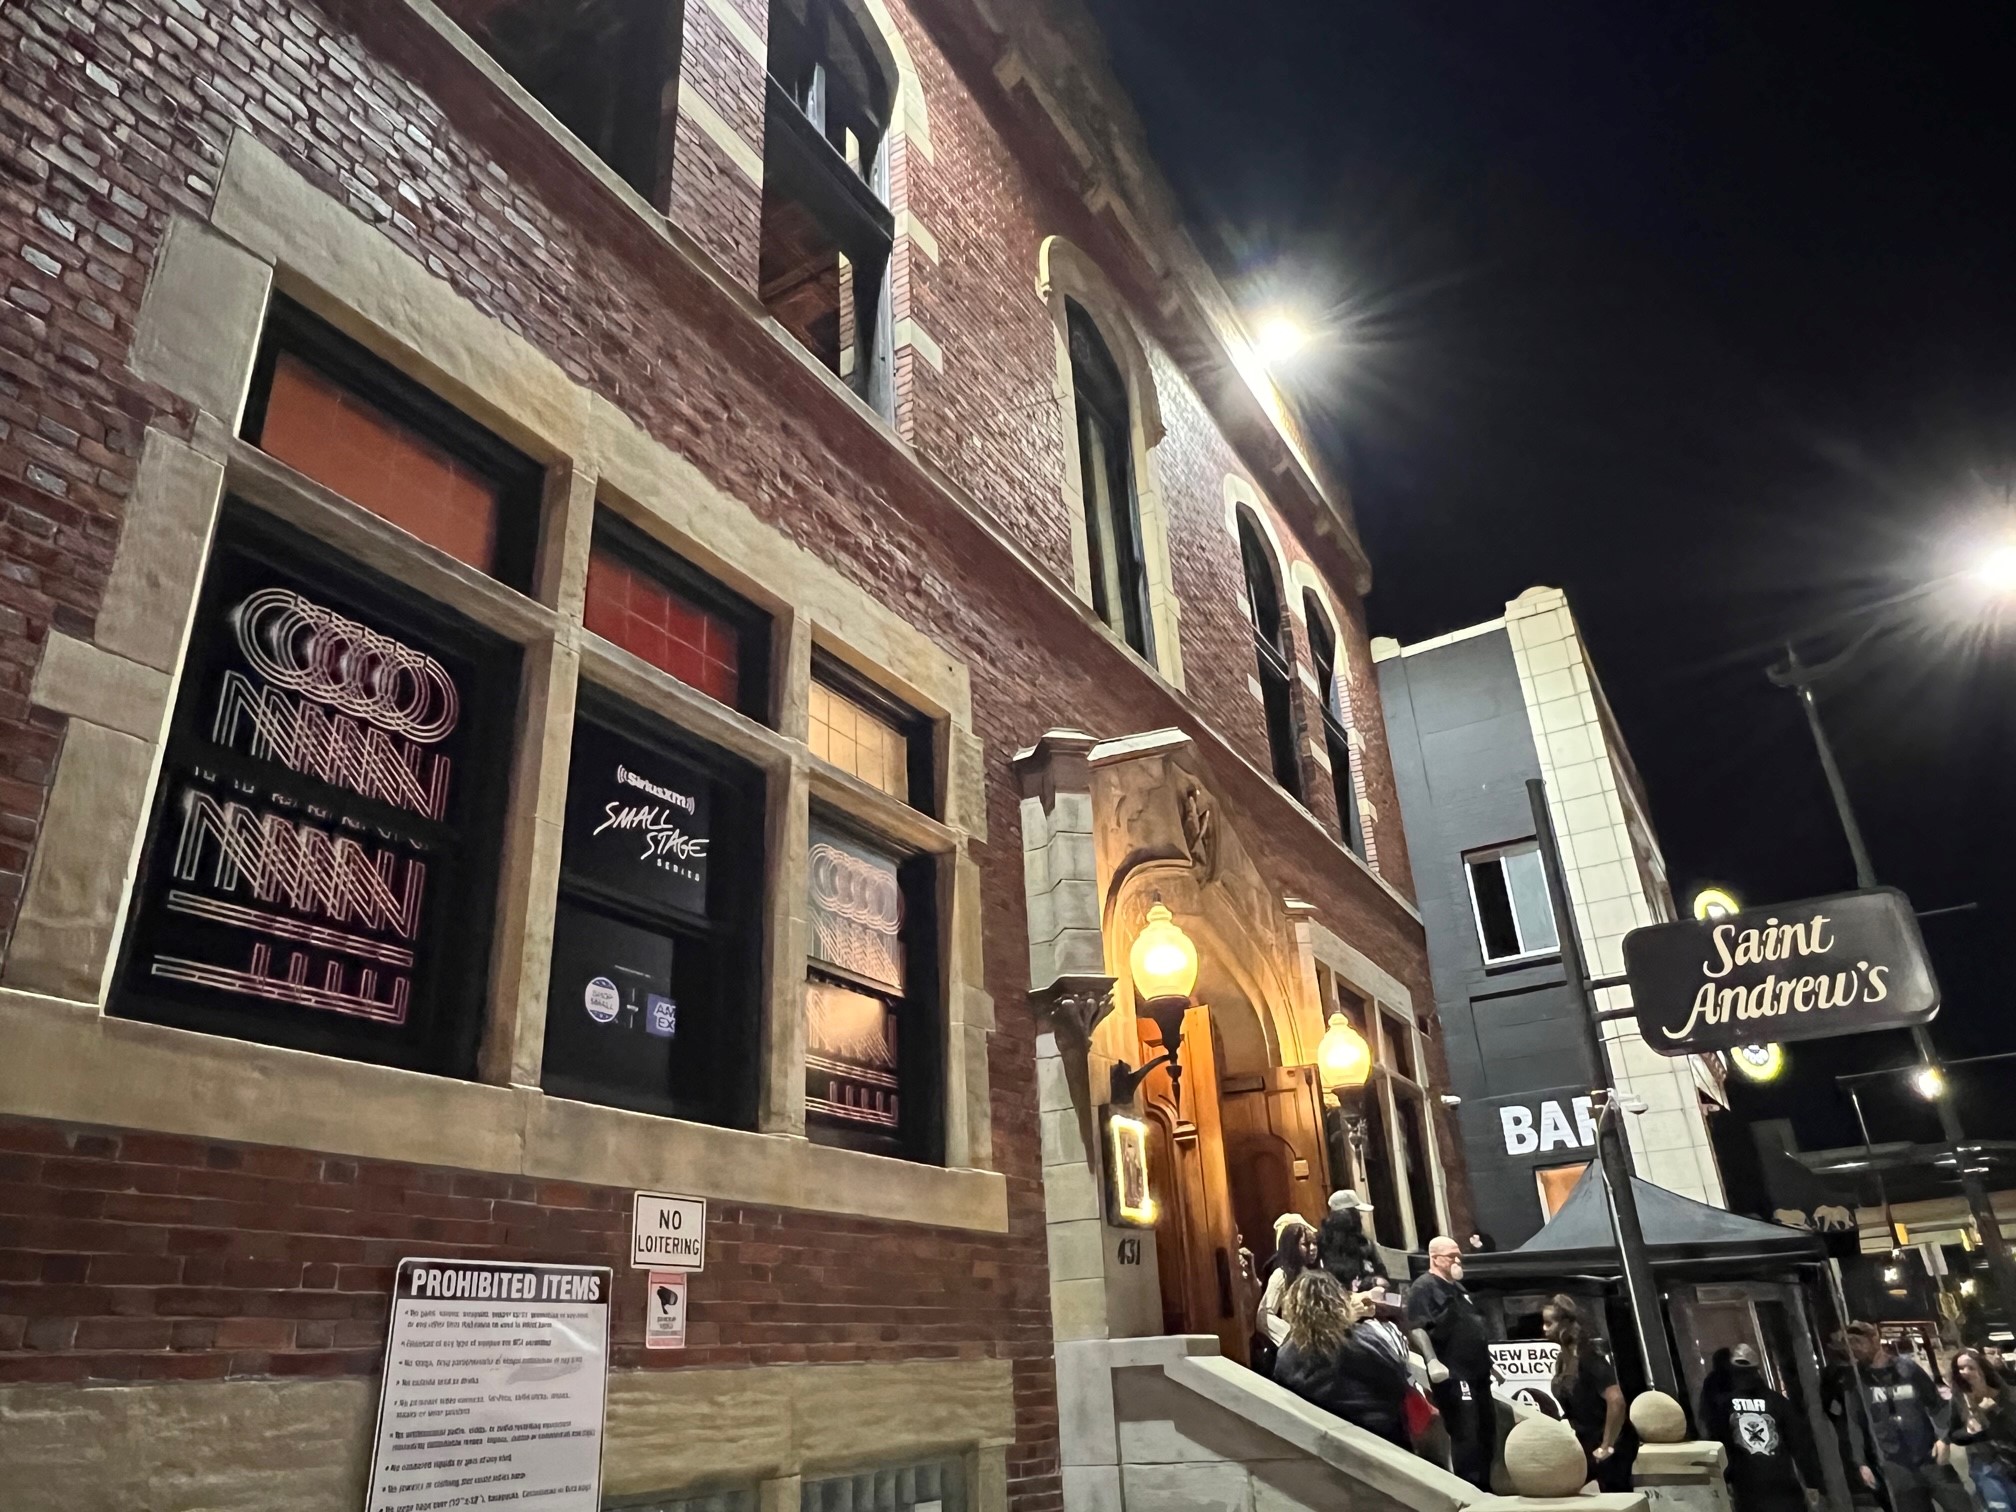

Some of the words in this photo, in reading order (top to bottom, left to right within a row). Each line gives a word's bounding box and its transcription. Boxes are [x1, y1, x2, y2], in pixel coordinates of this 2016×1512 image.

[593, 801, 674, 836] SMALL
[640, 828, 710, 860] STAGE
[656, 858, 700, 882] SERIES
[1702, 914, 1835, 978] Saint
[1661, 960, 1889, 1040] Andrew's
[659, 1209, 682, 1230] NO
[637, 1234, 700, 1256] LOITERING
[411, 1268, 538, 1300] PROHIBITED
[541, 1274, 601, 1301] ITEMS
[1490, 1349, 1521, 1362] NEW
[1528, 1348, 1559, 1361] BAG
